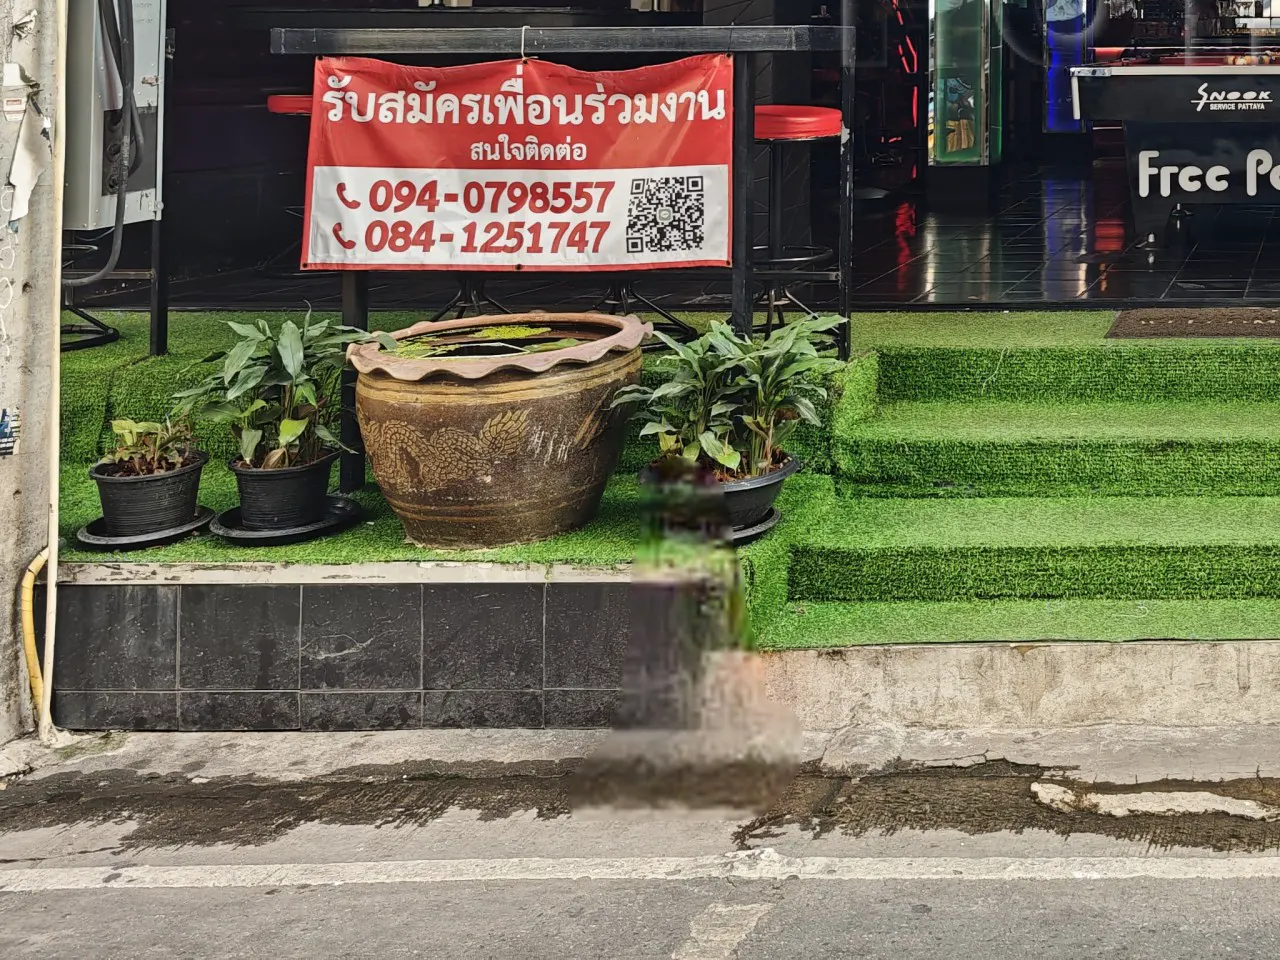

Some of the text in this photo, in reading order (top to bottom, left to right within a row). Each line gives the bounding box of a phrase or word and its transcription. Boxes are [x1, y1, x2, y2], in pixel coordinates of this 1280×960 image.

[321, 65, 727, 126] รับสมัครเพื่อนร่วมงาน
[1209, 102, 1265, 111] SERVICE PATTAYA
[469, 133, 588, 162] สนใจติดต่อ
[368, 180, 616, 215] 094-0798557
[364, 220, 611, 254] 084-1251747
